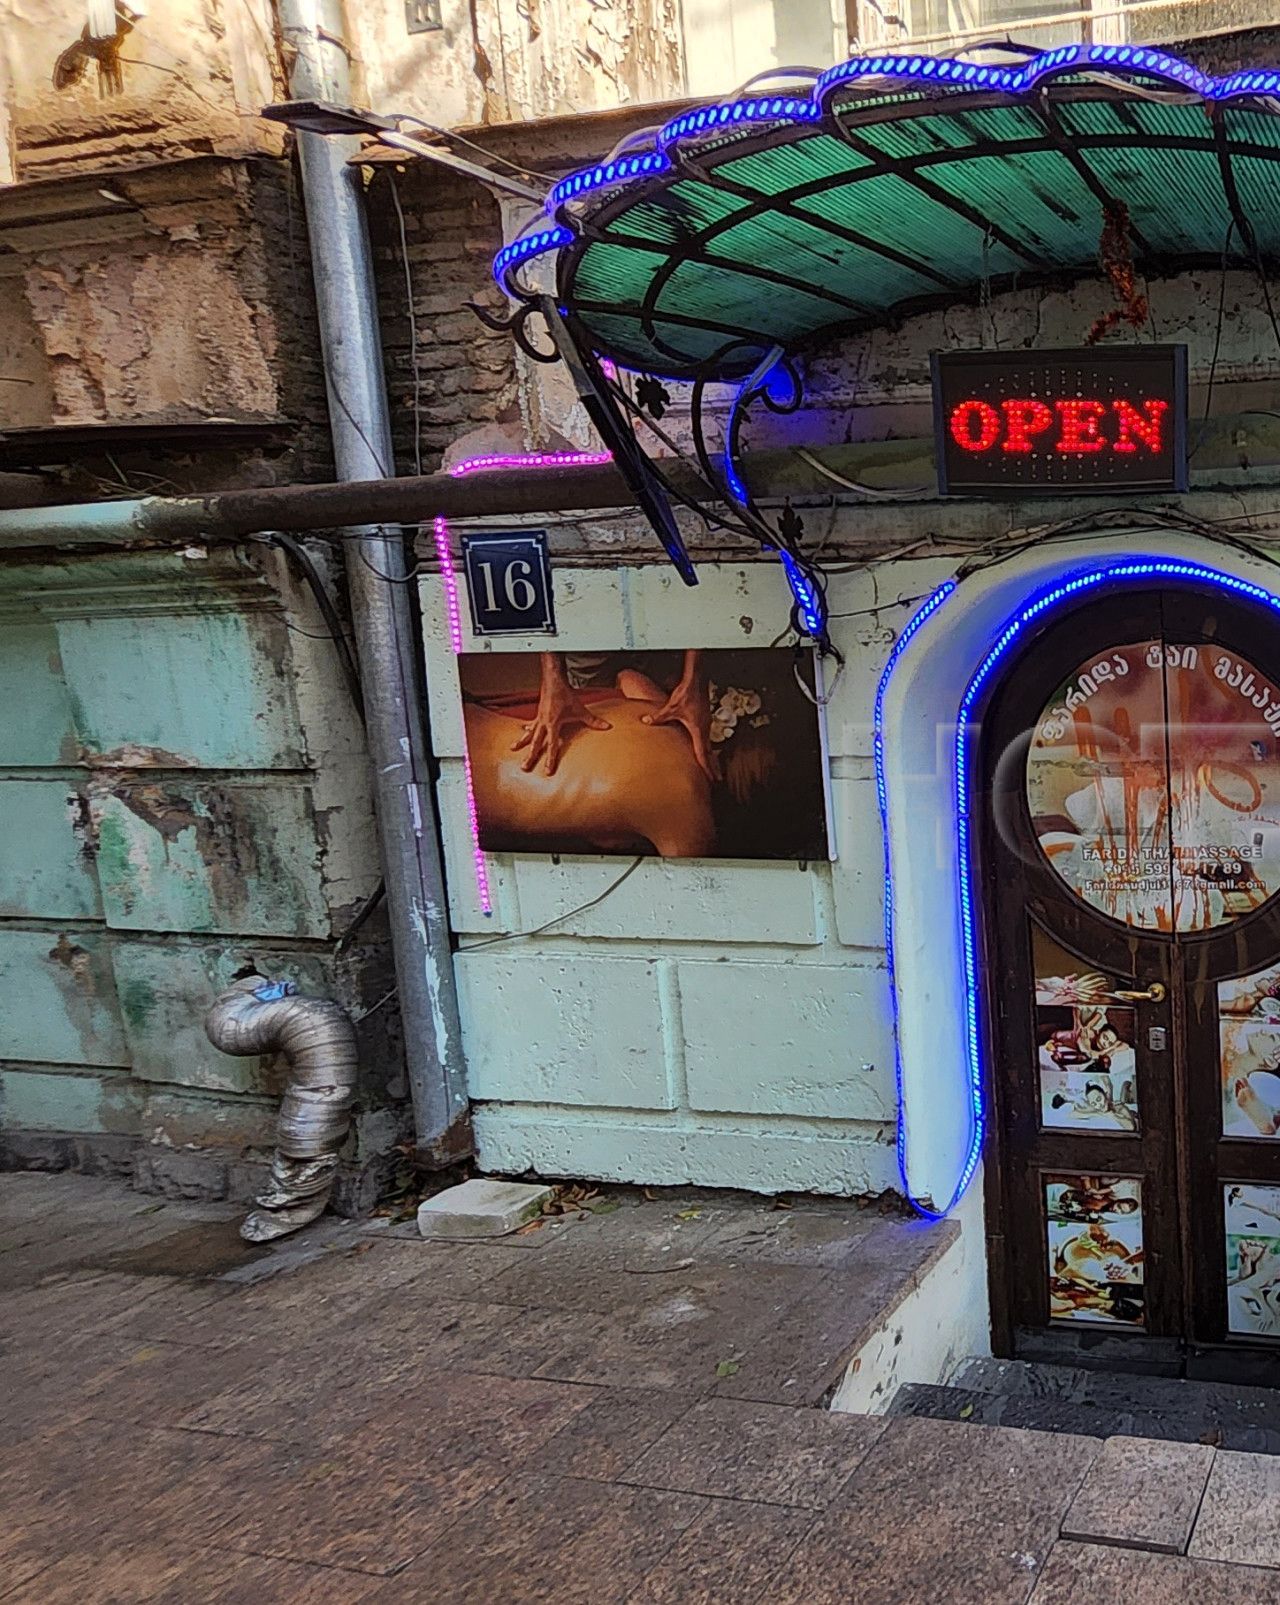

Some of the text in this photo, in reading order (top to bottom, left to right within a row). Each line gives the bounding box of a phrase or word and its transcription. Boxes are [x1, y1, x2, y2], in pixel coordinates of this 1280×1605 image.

[949, 398, 1169, 453] OPEN
[477, 559, 537, 613] 16
[1222, 861, 1242, 875] 89
